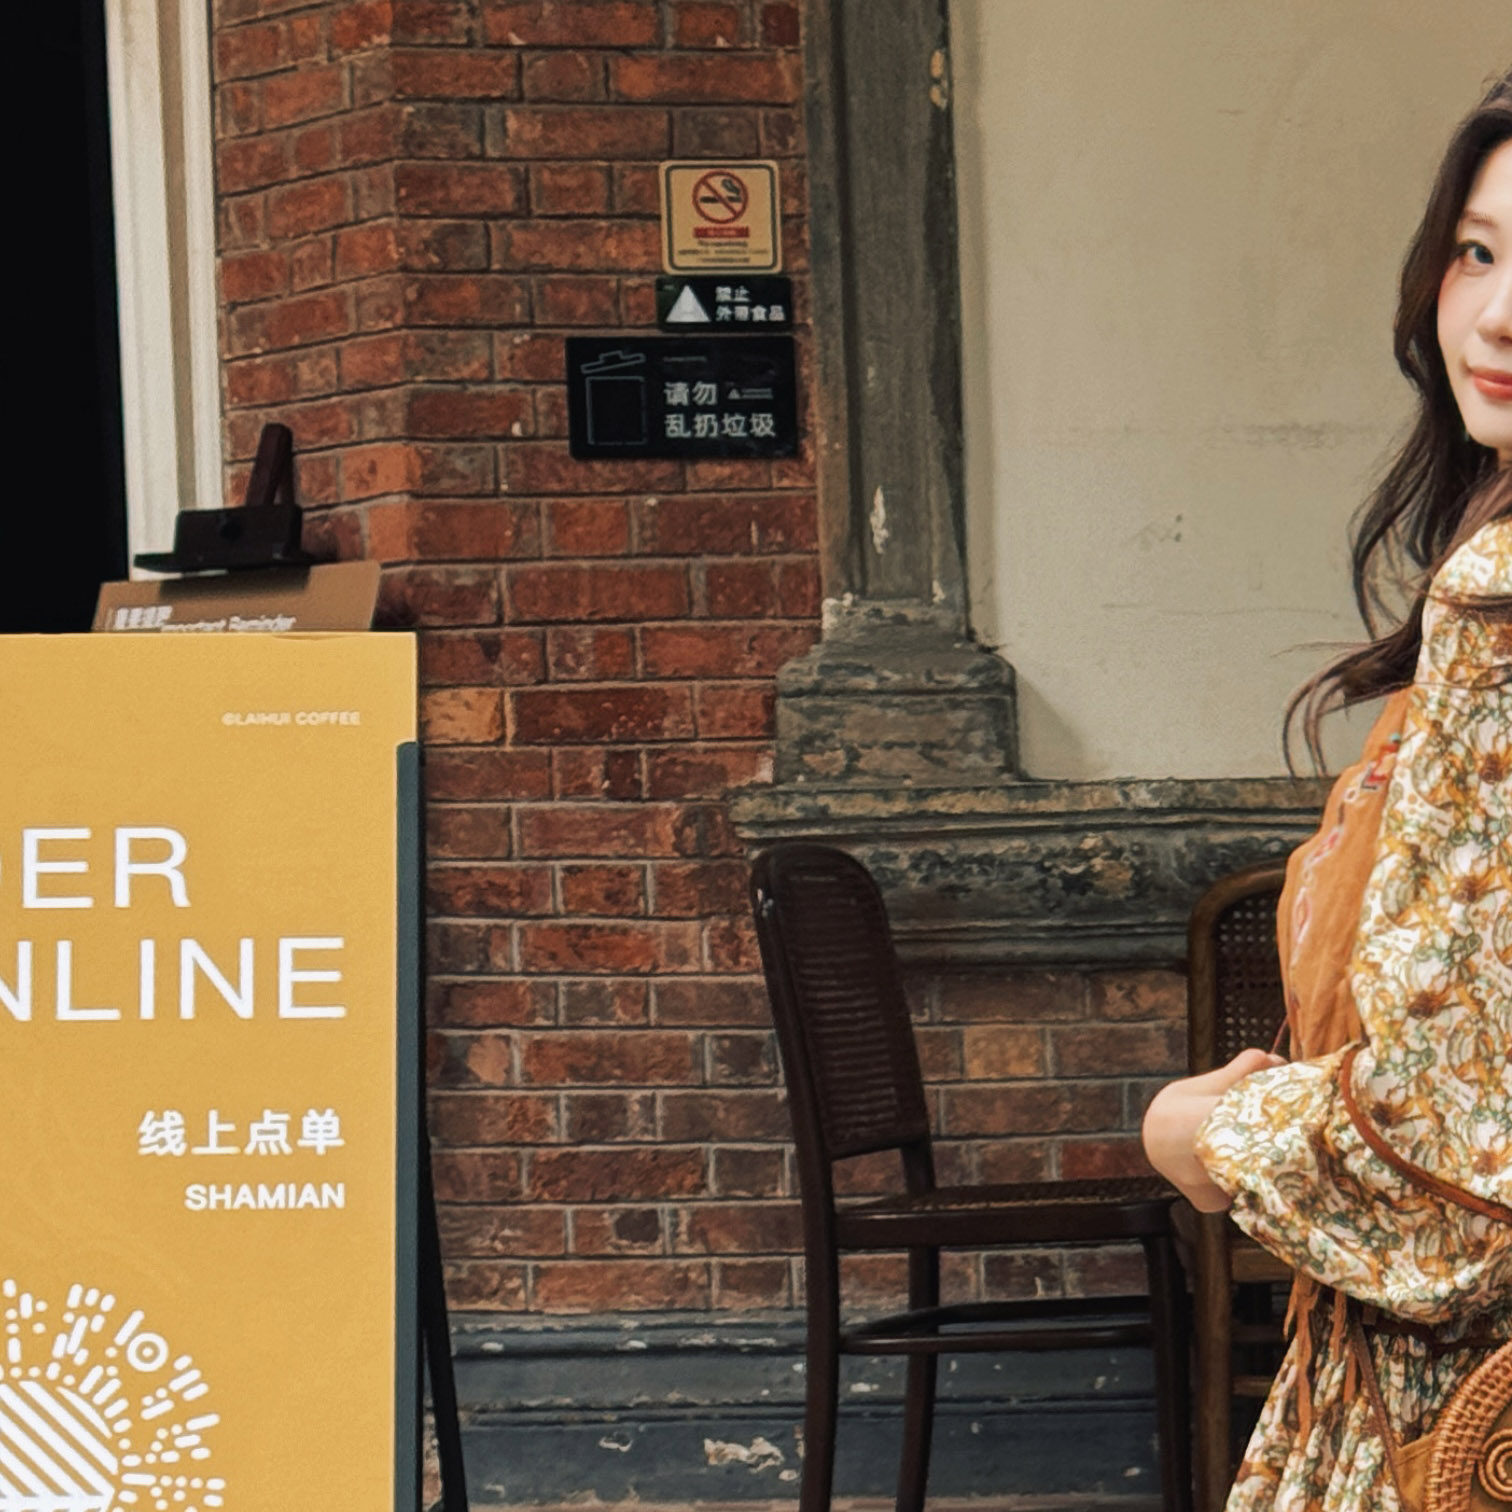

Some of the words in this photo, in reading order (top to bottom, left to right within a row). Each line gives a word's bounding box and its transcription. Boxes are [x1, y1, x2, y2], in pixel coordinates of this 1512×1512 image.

[664, 381, 718, 406] 请勿
[664, 413, 776, 438] 乱扔垃圾
[295, 711, 361, 726] COFFEE
[0, 826, 191, 909] ER
[138, 1108, 345, 1156] 线上点单
[184, 1182, 345, 1211] SHAMIAN
